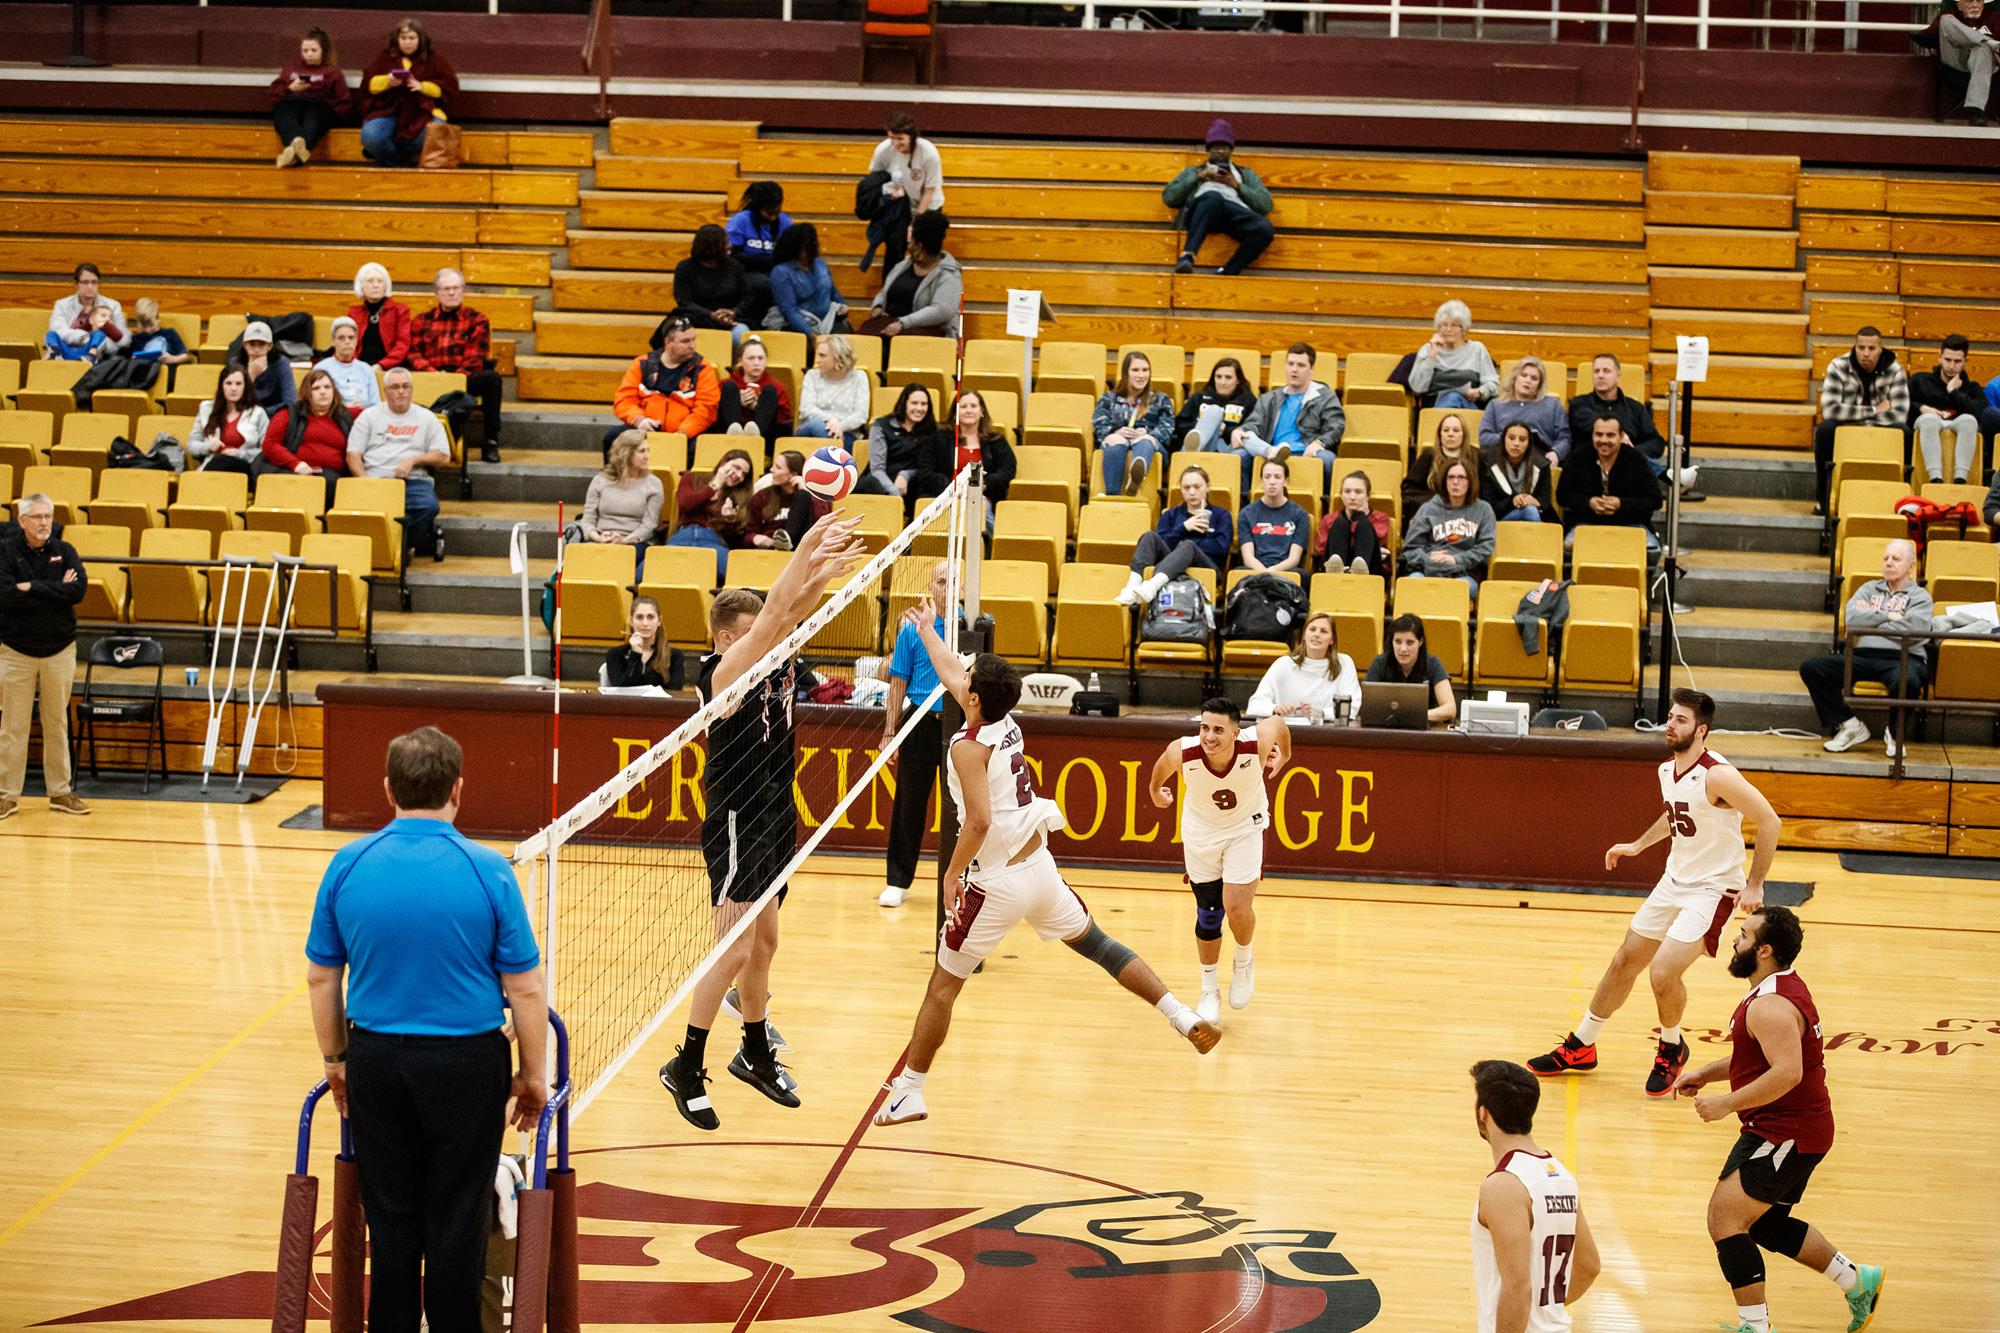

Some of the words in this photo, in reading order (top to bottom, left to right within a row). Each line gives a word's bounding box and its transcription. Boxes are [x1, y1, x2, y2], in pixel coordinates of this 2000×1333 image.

[1027, 683, 1070, 699] FLEET
[1023, 755, 1376, 853] OLGE
[1211, 788, 1237, 811] 9
